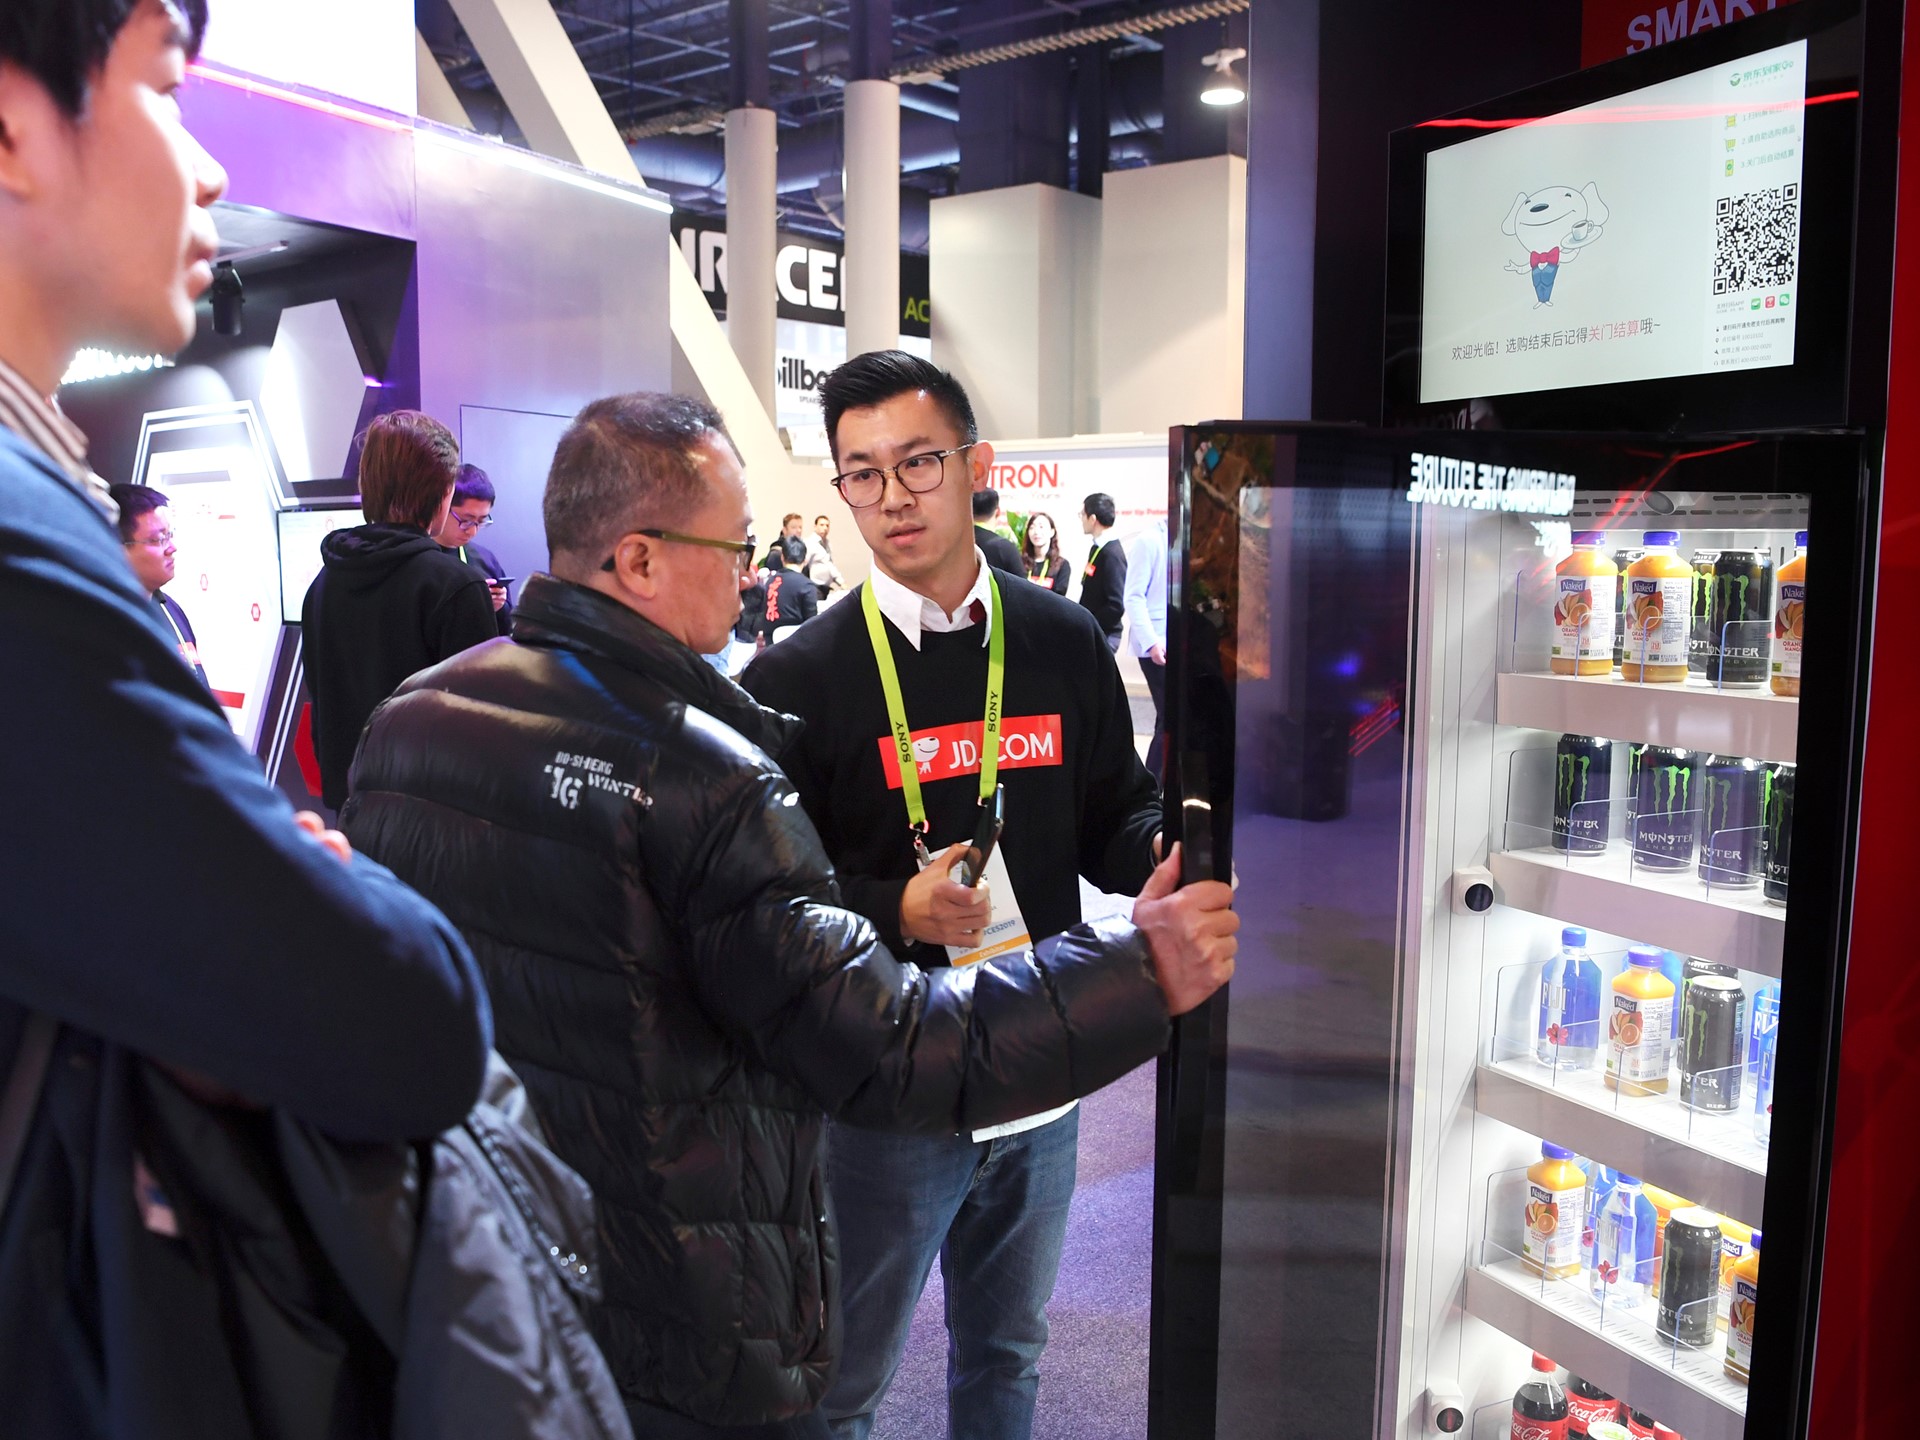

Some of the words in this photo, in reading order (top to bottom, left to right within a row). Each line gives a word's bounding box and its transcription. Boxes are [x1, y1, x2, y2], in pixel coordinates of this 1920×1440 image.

[1562, 581, 1584, 592] Naked
[1634, 582, 1654, 593] Naked
[1784, 588, 1805, 598] Nake
[988, 691, 999, 732] SONY
[896, 721, 912, 763] SONY
[1555, 816, 1599, 830] ONSTER
[984, 919, 1016, 936] CES2019
[1615, 997, 1636, 1011] Naked
[1531, 1189, 1551, 1203] Naked
